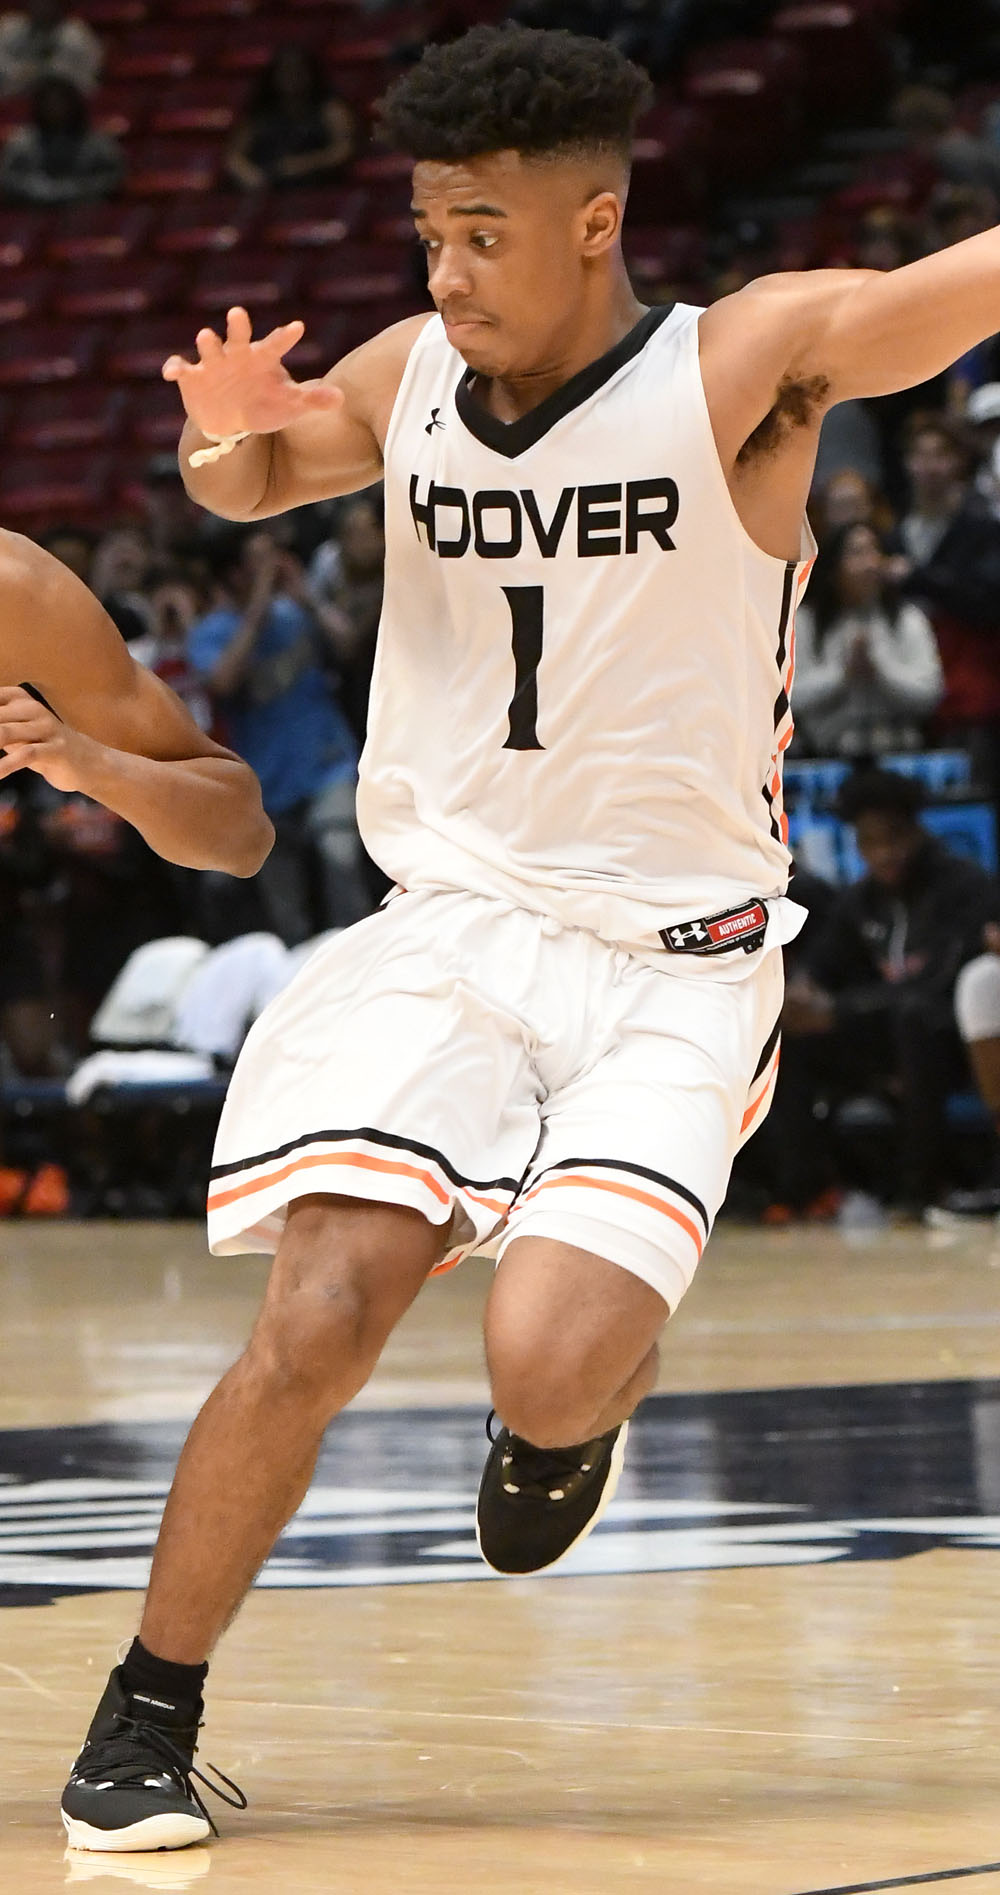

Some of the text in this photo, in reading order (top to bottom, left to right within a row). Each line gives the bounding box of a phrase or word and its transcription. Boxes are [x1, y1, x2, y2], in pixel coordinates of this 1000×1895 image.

[409, 473, 680, 559] HOOVER
[499, 585, 547, 751] 1
[718, 913, 757, 937] AUTHENTIC
